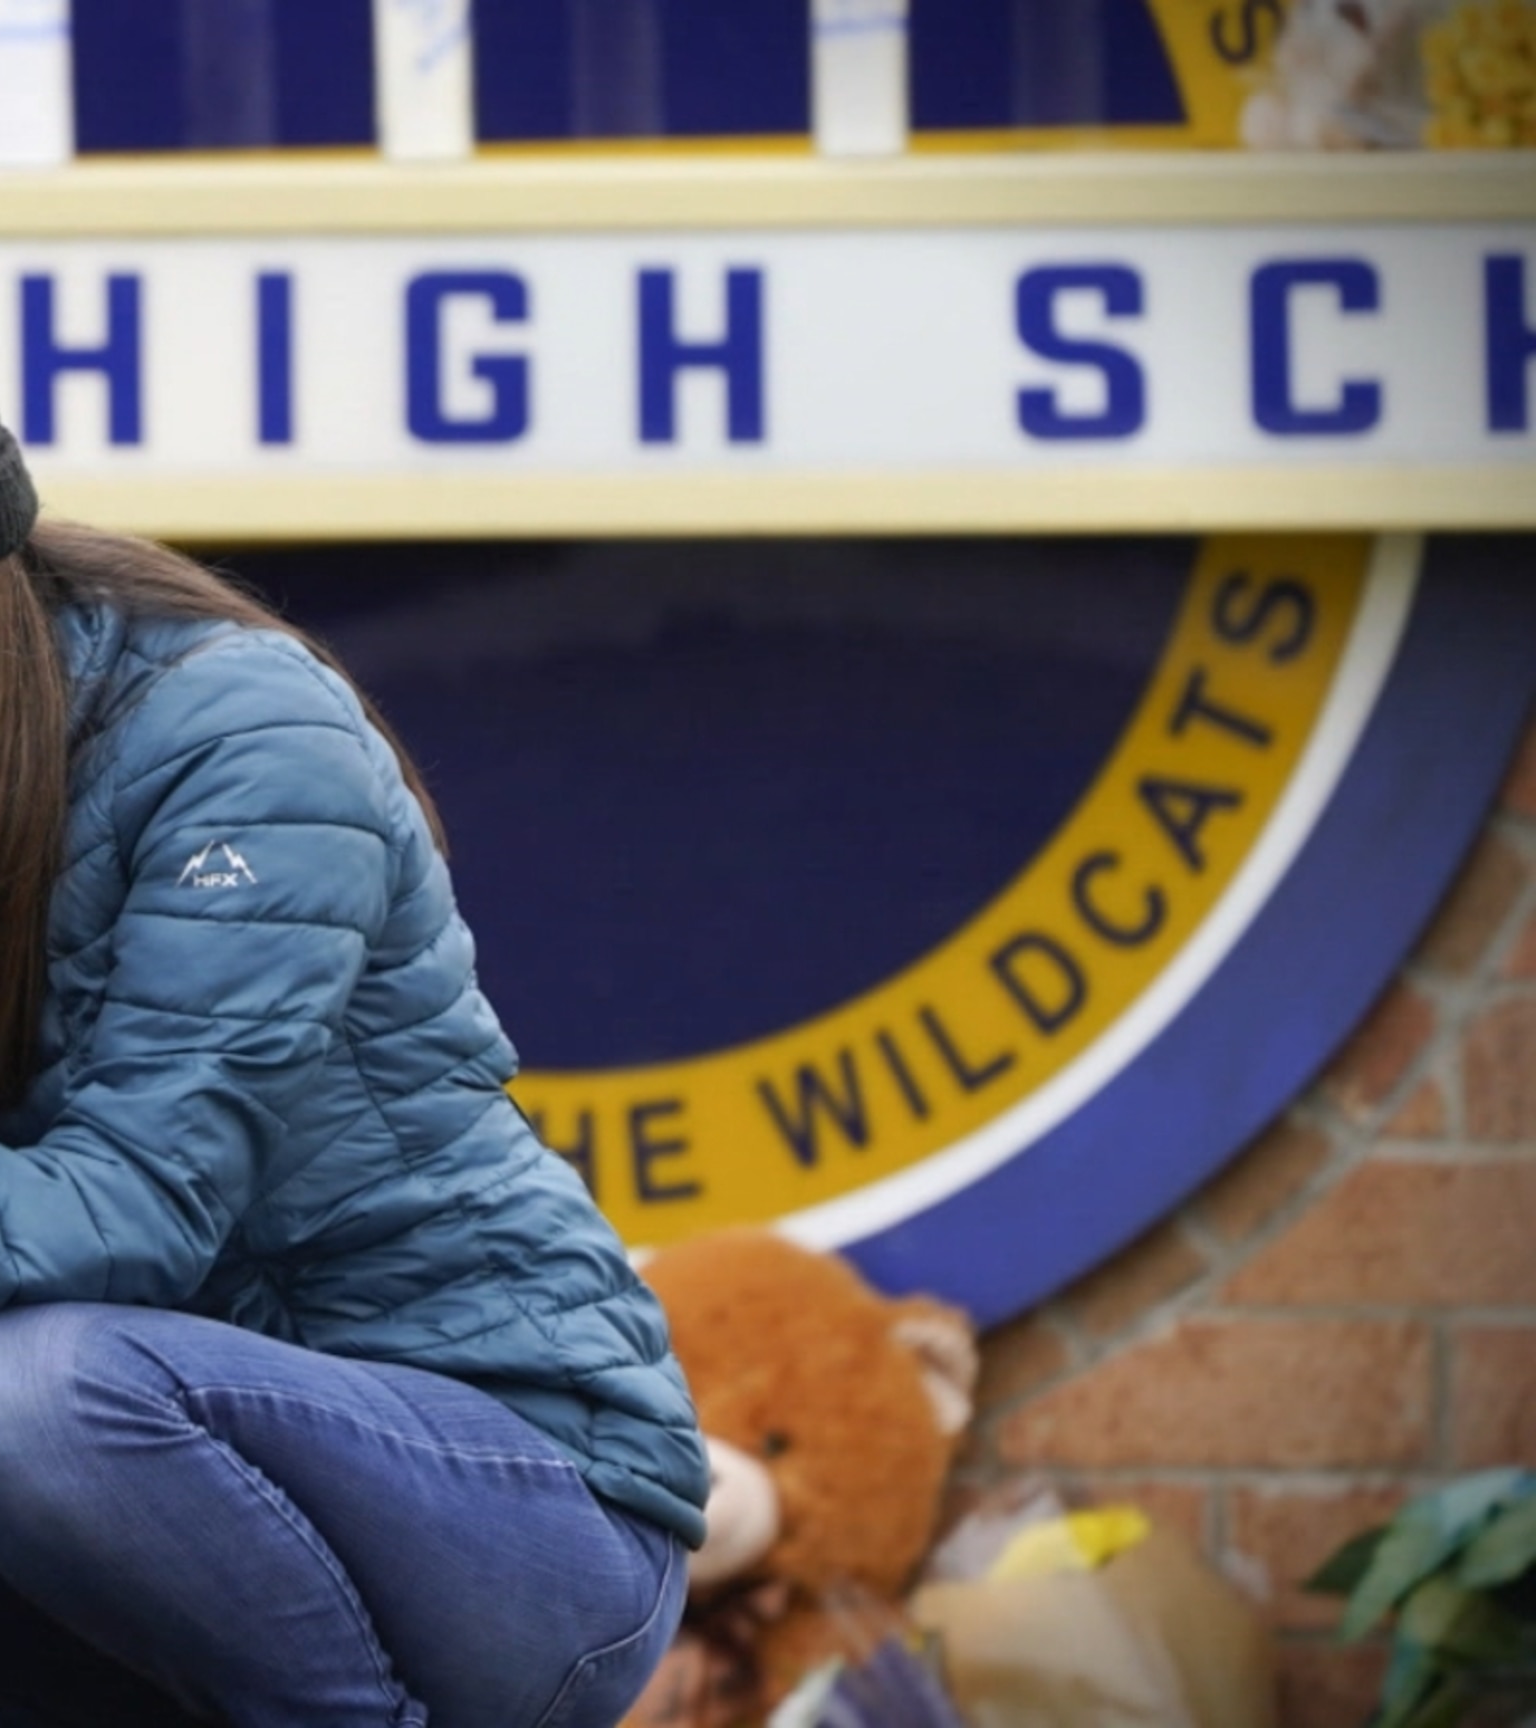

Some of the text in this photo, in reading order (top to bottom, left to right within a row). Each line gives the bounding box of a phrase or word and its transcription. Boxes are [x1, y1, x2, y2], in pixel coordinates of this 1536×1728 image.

[19, 266, 766, 447] HIGH
[192, 872, 239, 888] HFX
[528, 568, 1317, 1205] HE WILDCATS
